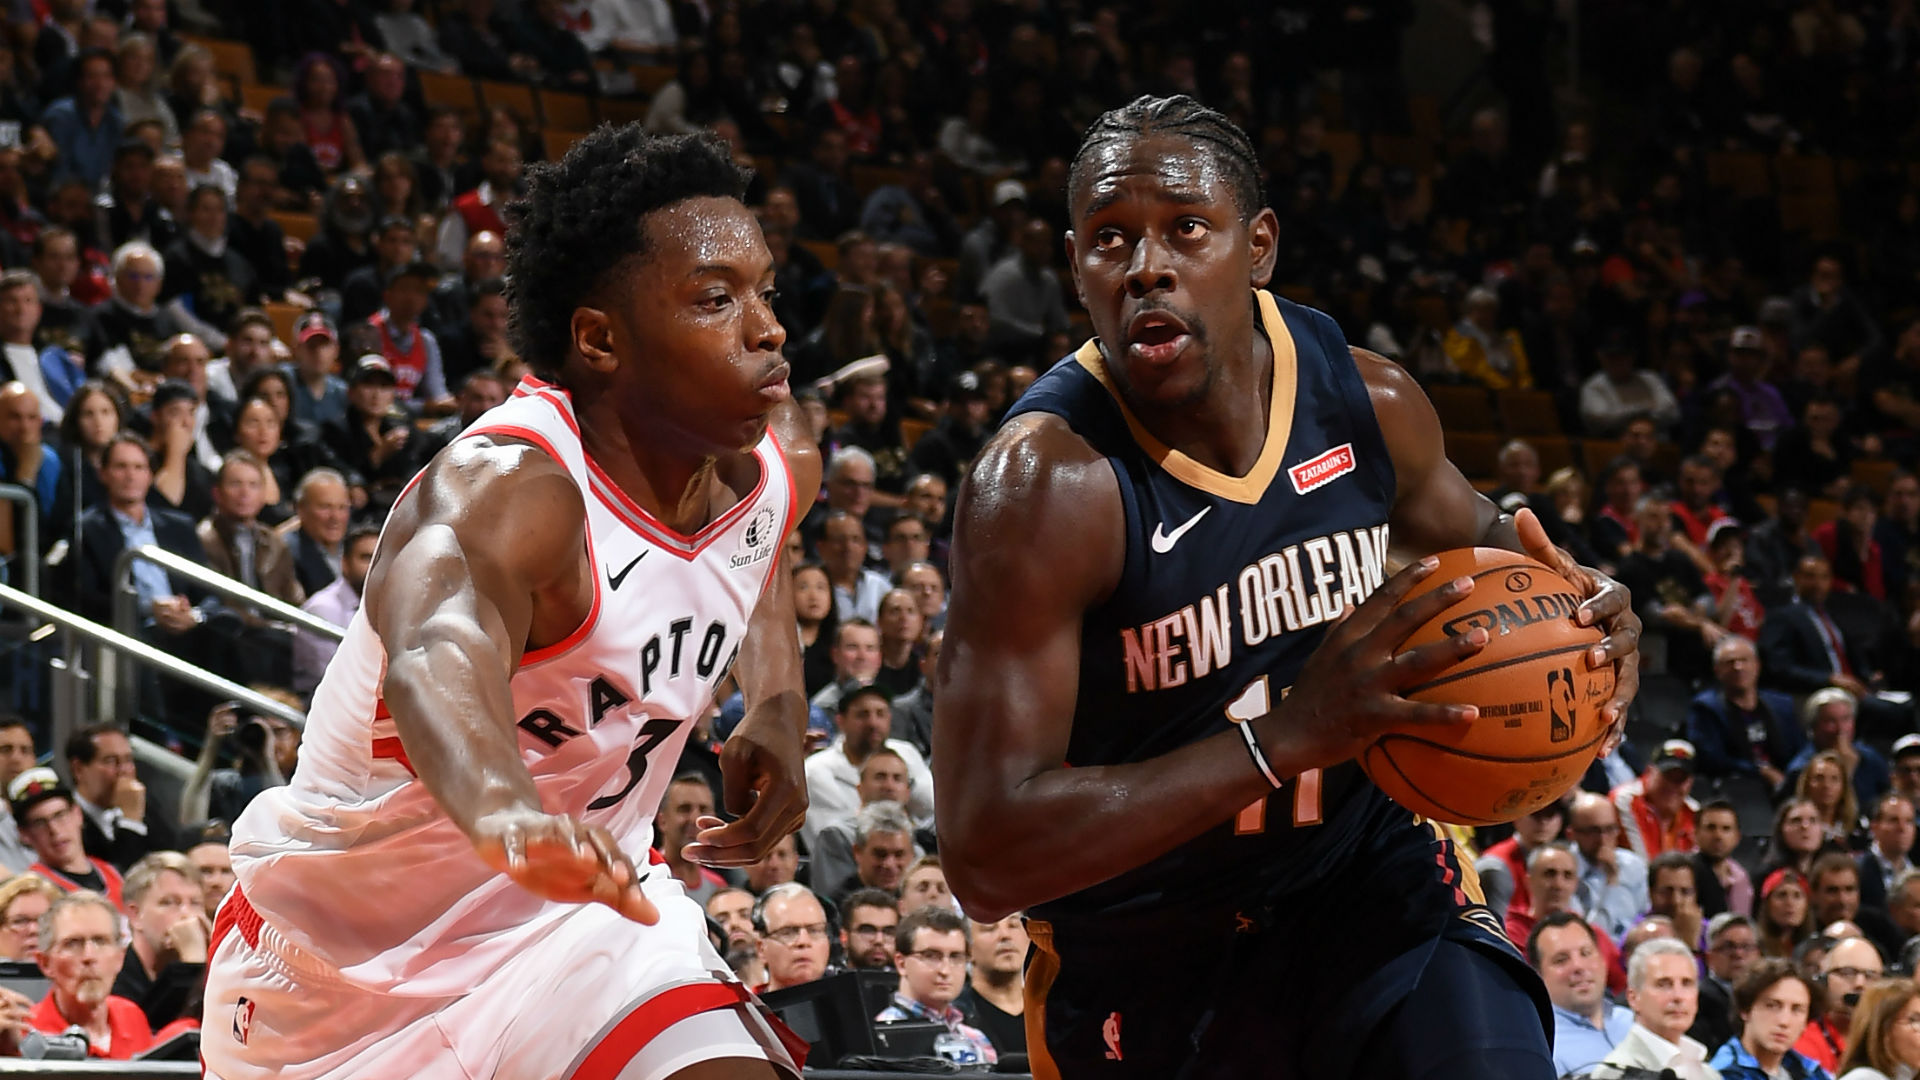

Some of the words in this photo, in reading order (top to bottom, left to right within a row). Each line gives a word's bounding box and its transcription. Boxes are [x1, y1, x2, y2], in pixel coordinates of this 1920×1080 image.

[1299, 452, 1349, 483] ZATARAIN'S
[729, 554, 752, 569] Sun
[1442, 592, 1585, 637] SPALDIN
[1120, 582, 1232, 693] NEW
[1510, 701, 1528, 715] GAME
[1528, 699, 1543, 713] BALL
[586, 717, 685, 812] 3
